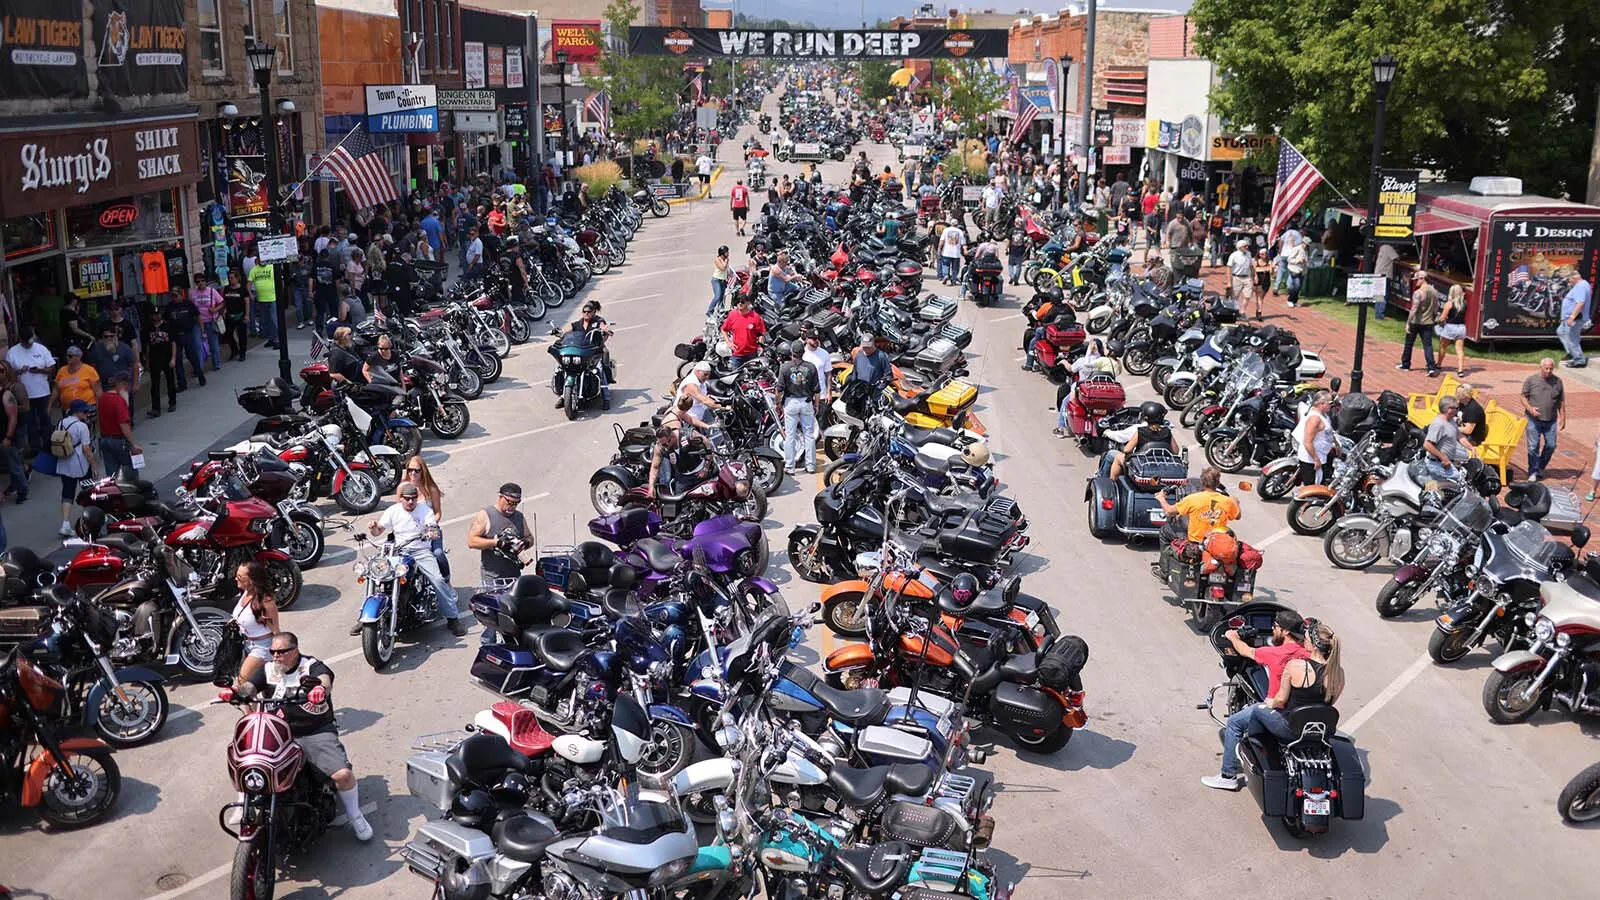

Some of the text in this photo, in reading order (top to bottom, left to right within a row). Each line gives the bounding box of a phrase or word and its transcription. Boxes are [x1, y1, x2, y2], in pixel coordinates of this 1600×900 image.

[4, 15, 81, 47] LAW TIGERS
[556, 28, 591, 37] WELL
[558, 37, 595, 46] FARGO
[718, 31, 921, 56] WE RUN DEEP
[376, 89, 396, 101] Town
[397, 95, 427, 108] Country
[478, 91, 495, 99] BAR
[382, 115, 433, 130] PLUMBING
[135, 127, 179, 152] SHIRT
[138, 154, 182, 179] SHACK
[1381, 177, 1417, 192] Sturgis
[102, 209, 136, 224] OPEN
[1504, 221, 1529, 238] #1
[81, 262, 110, 276] SHIRT
